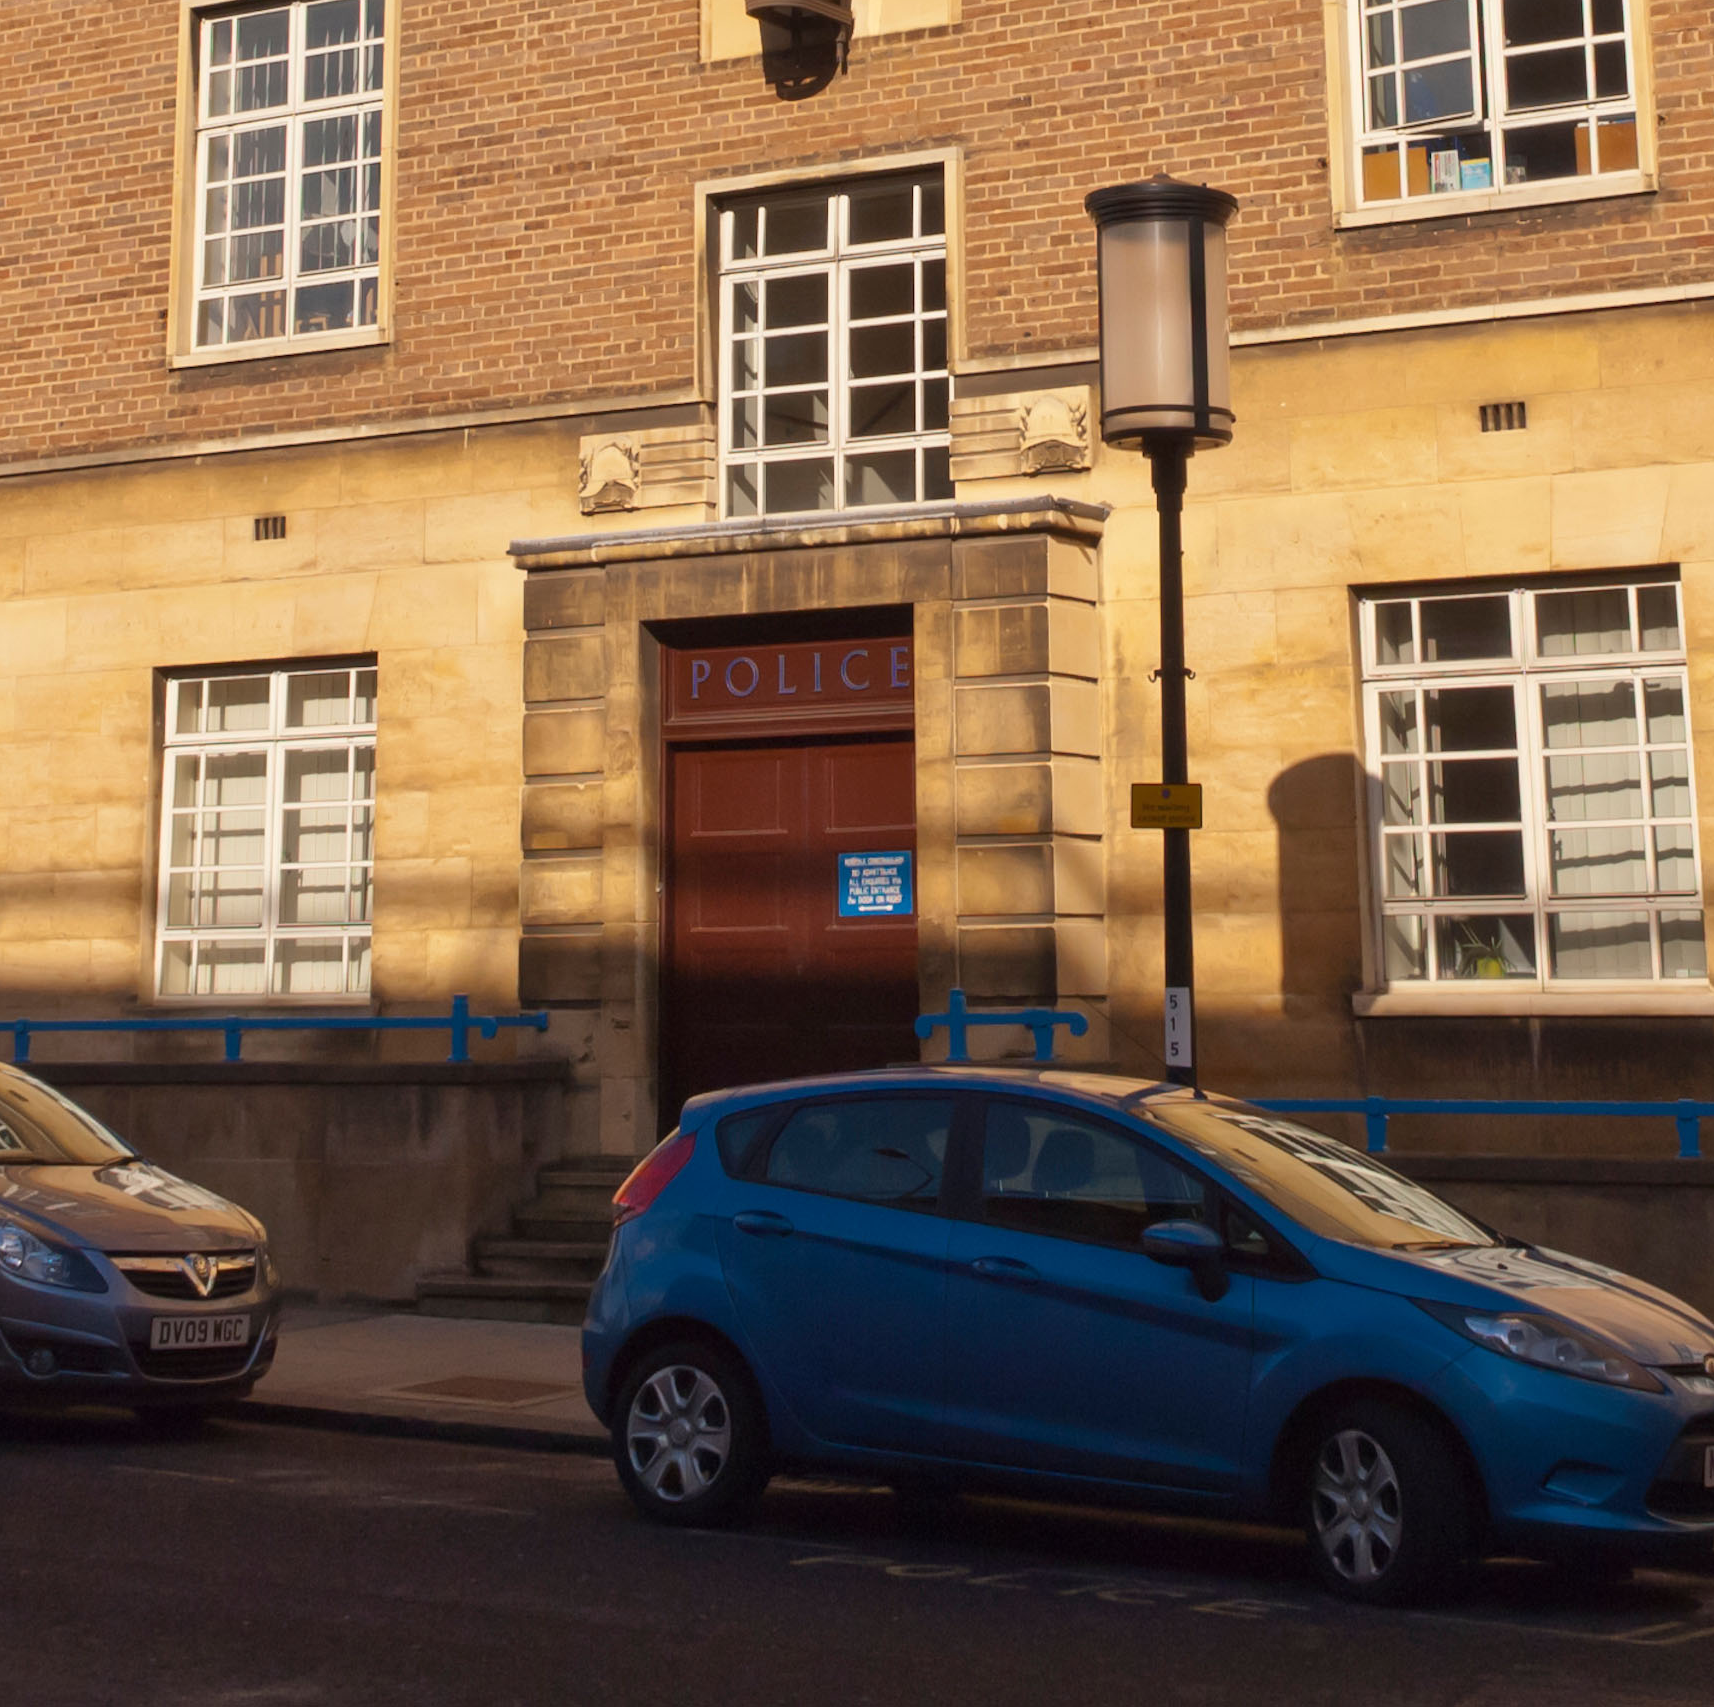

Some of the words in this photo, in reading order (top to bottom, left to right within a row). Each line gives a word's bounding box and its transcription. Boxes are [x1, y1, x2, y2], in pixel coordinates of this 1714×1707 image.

[691, 647, 910, 699] POLICE
[159, 1320, 208, 1345] DV09
[213, 1318, 243, 1342] WGC
